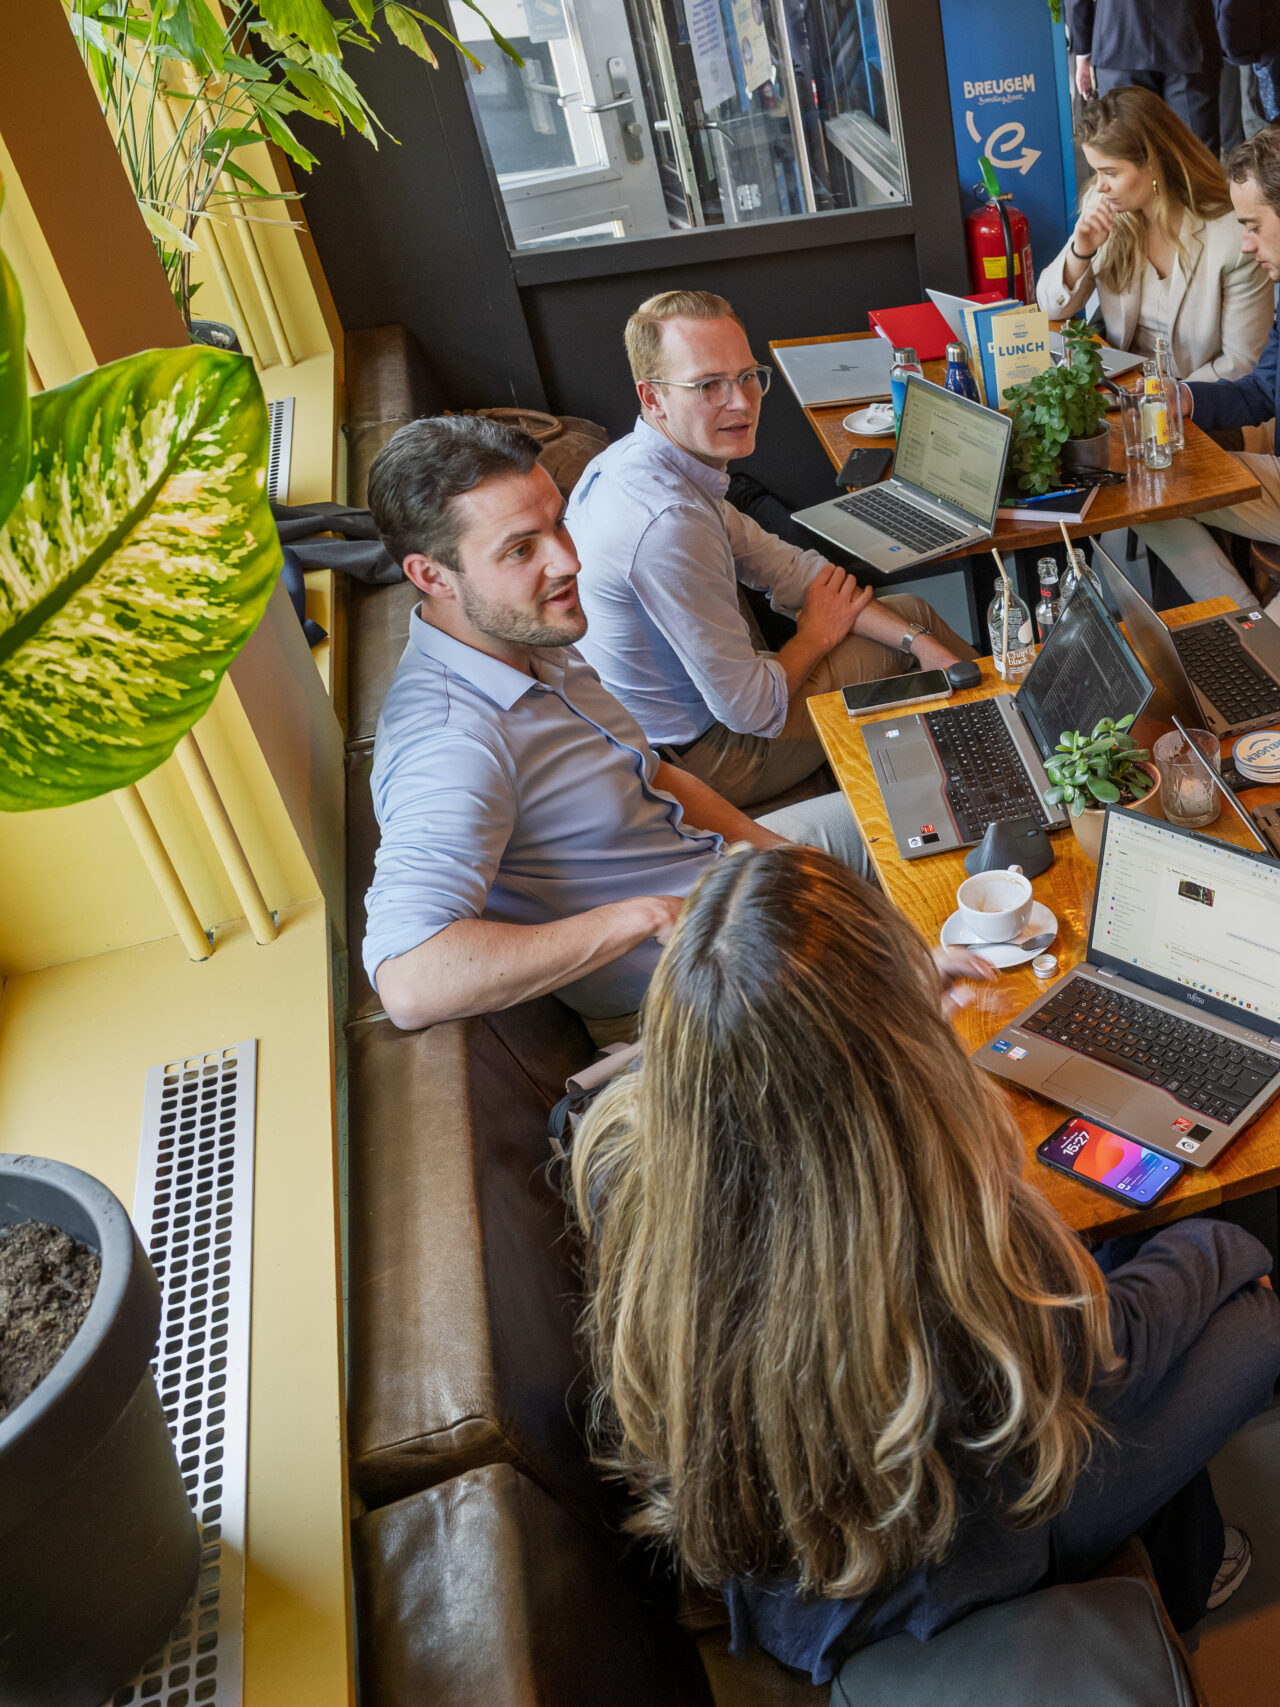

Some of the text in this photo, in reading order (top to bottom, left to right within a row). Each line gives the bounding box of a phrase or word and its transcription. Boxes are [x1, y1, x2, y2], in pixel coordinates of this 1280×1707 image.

[963, 73, 1035, 99] BREUGEM
[998, 341, 1044, 357] LUNCH
[1063, 1130, 1090, 1155] 15:27
